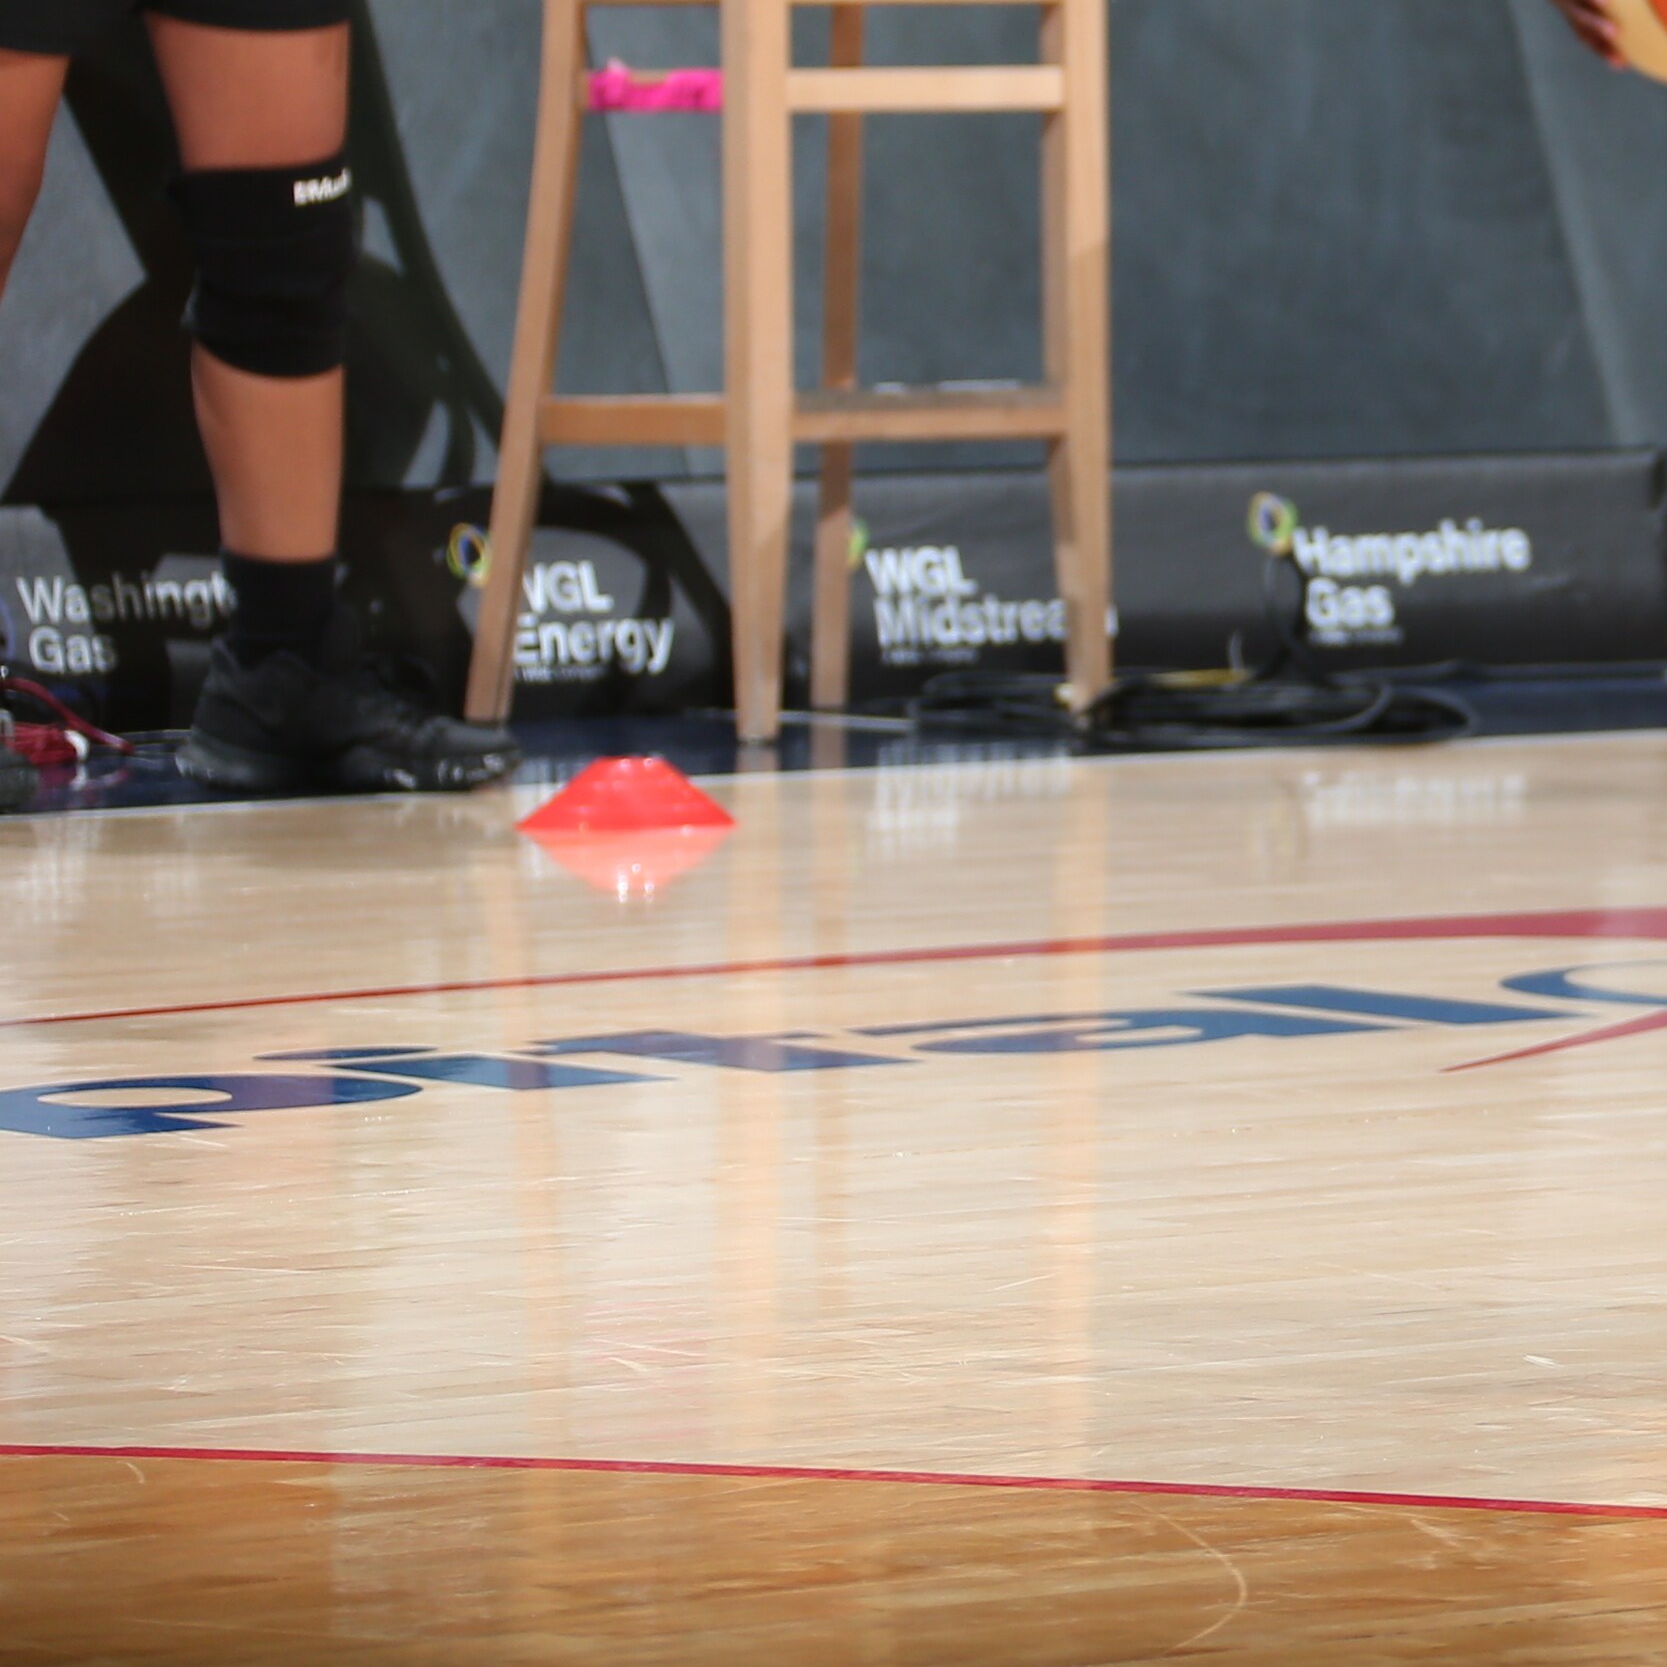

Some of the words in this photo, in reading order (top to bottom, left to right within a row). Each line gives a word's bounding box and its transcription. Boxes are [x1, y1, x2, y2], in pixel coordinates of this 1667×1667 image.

[865, 545, 979, 596] WGL
[1292, 516, 1532, 587] Hampshire
[16, 571, 238, 631] Washingt
[873, 592, 1118, 648] Midstrea
[1306, 576, 1395, 628] Gas
[28, 625, 117, 673] Gas
[513, 612, 674, 675] Energy
